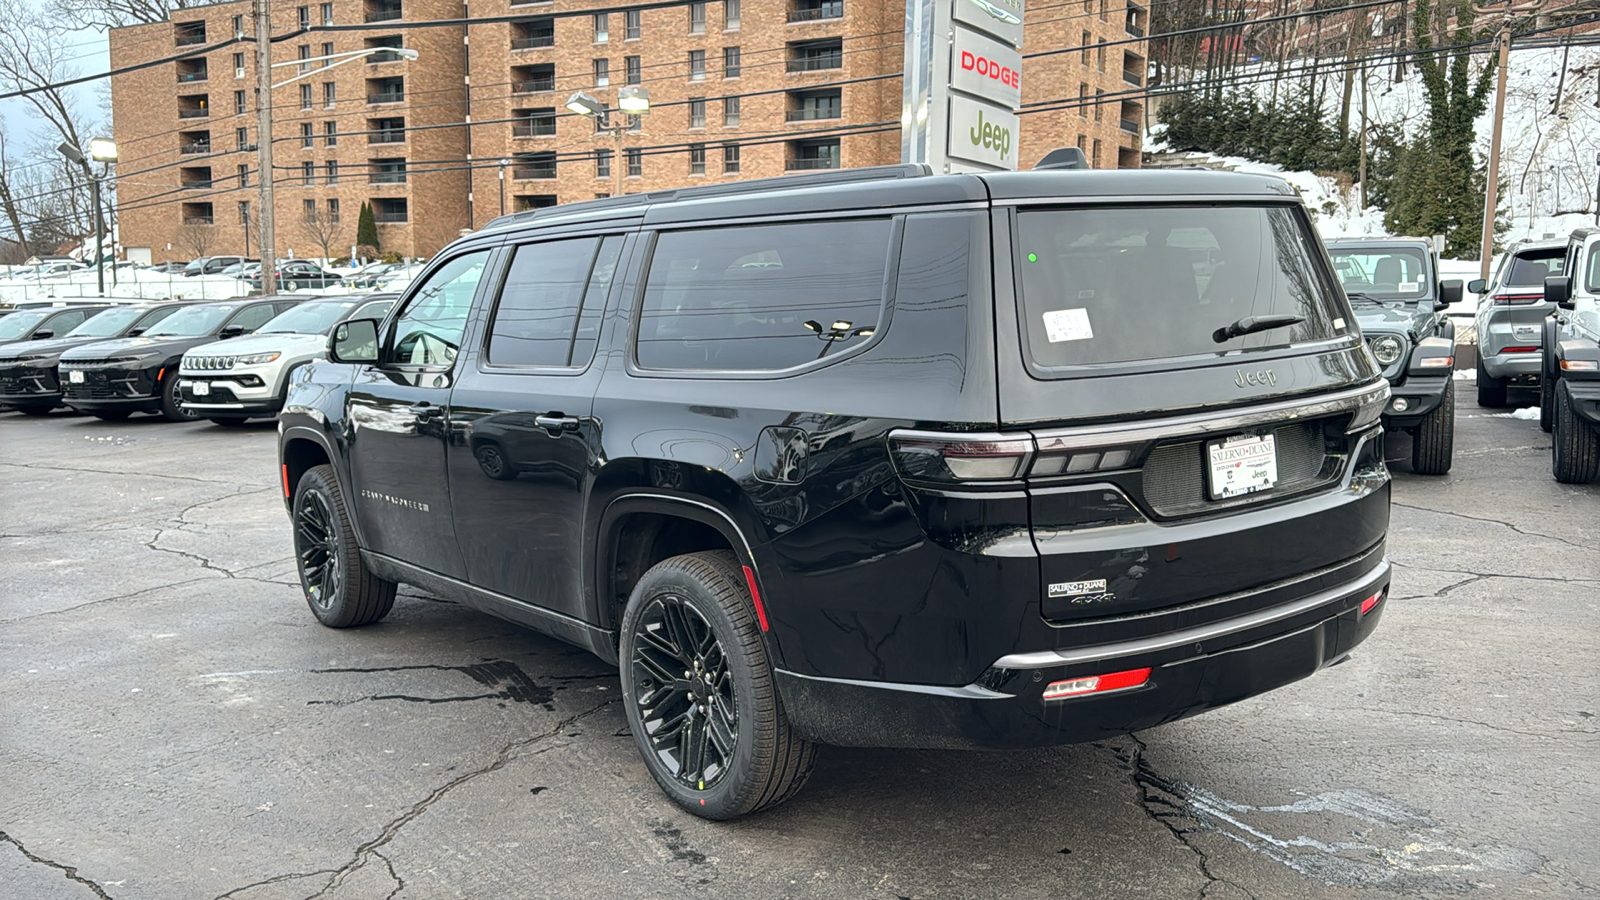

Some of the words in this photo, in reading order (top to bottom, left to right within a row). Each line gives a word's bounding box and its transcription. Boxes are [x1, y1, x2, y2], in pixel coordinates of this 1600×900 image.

[961, 50, 1019, 90] DODGE
[970, 109, 1010, 160] Jeep
[1234, 369, 1277, 388] Jeep
[1212, 447, 1245, 463] SALERNO
[1248, 442, 1274, 456] DUANE
[1252, 470, 1267, 479] Jeep
